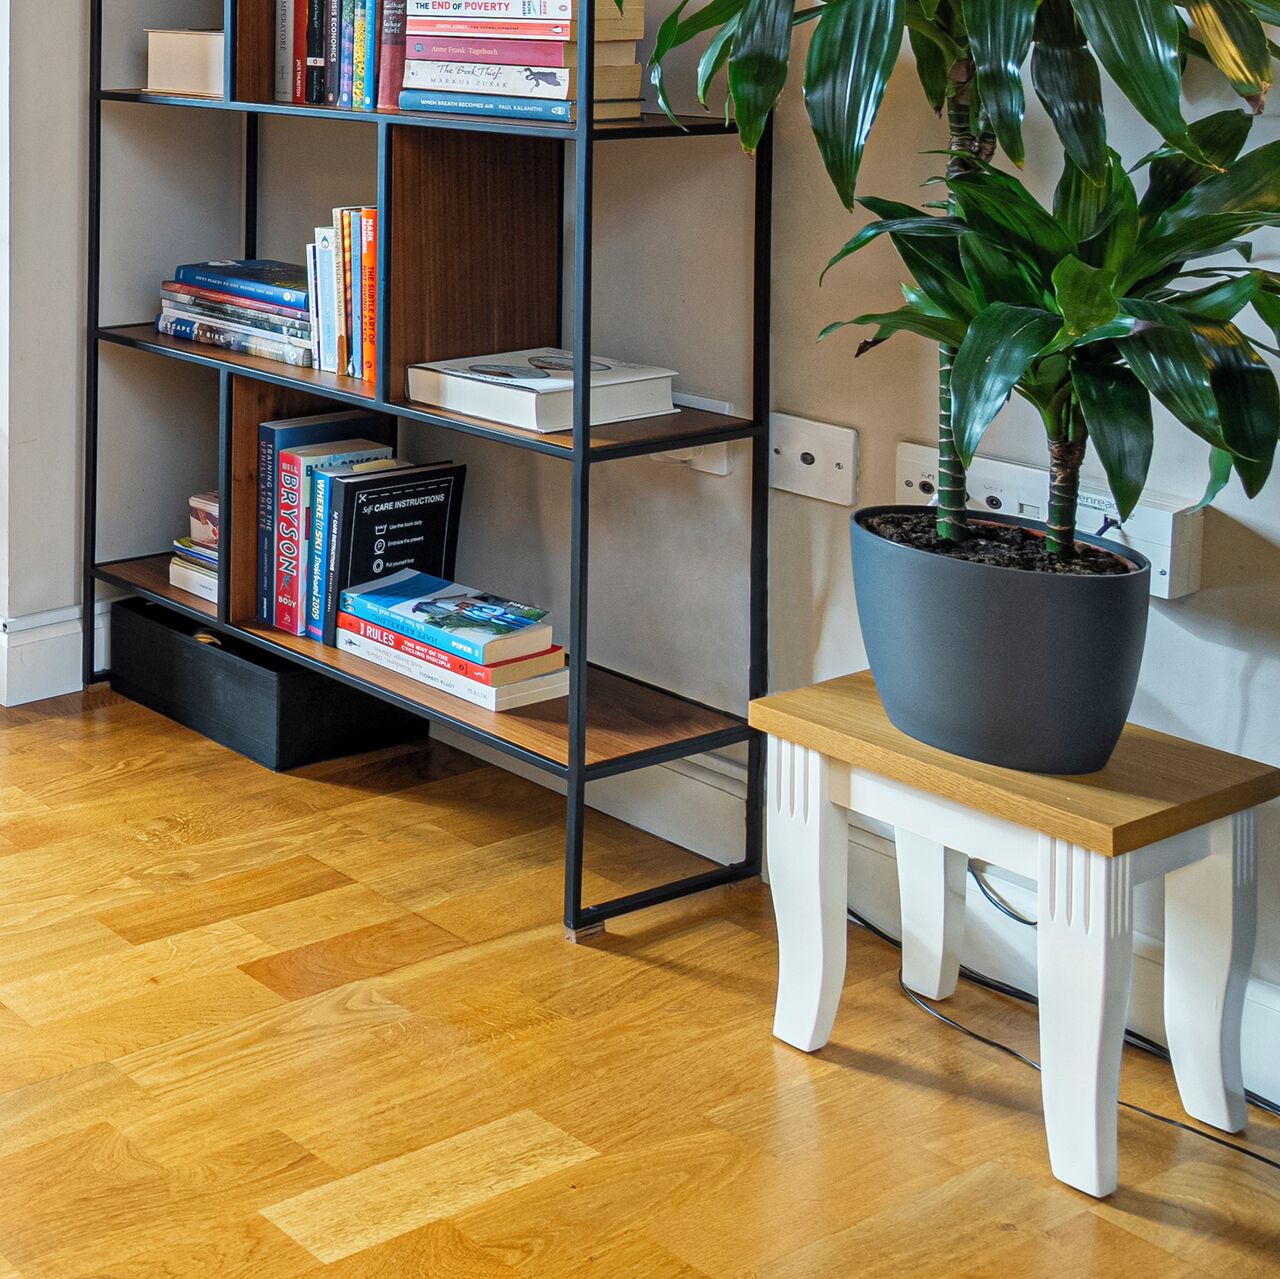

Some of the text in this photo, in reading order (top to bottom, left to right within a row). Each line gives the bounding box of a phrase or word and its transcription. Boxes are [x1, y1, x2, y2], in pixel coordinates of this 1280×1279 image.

[415, 2, 430, 10] THE
[431, 1, 451, 10] END
[464, 2, 510, 11] POVERTY
[448, 46, 466, 54] Frank
[468, 47, 498, 57] Tagebuch
[437, 64, 503, 80] The Book Thief
[430, 77, 508, 89] MARKUS ZUSAK
[513, 105, 543, 113] KALANITHI
[366, 218, 374, 243] MARK
[367, 283, 375, 314] SUBTLE
[206, 332, 225, 342] BIKE
[368, 333, 375, 345] OF
[282, 462, 298, 473] BILL
[315, 479, 325, 520] WHERE
[362, 493, 445, 515] Self CARE INSTRUCTIONS
[1078, 494, 1118, 511] enreac
[278, 471, 299, 578] BRYSON
[413, 519, 423, 527] daily
[314, 530, 323, 550] SKI
[387, 539, 403, 547] Embrace
[278, 596, 297, 608] BODY
[311, 596, 320, 620] 2009
[371, 613, 417, 638] KERKELING
[366, 625, 395, 647] RULES
[417, 630, 439, 645] HAPE
[403, 639, 449, 662] THE WAY OF THE
[451, 640, 472, 654] PIPER
[400, 645, 451, 669] CYCLING DISCIPLE
[467, 687, 488, 700] MALIK
